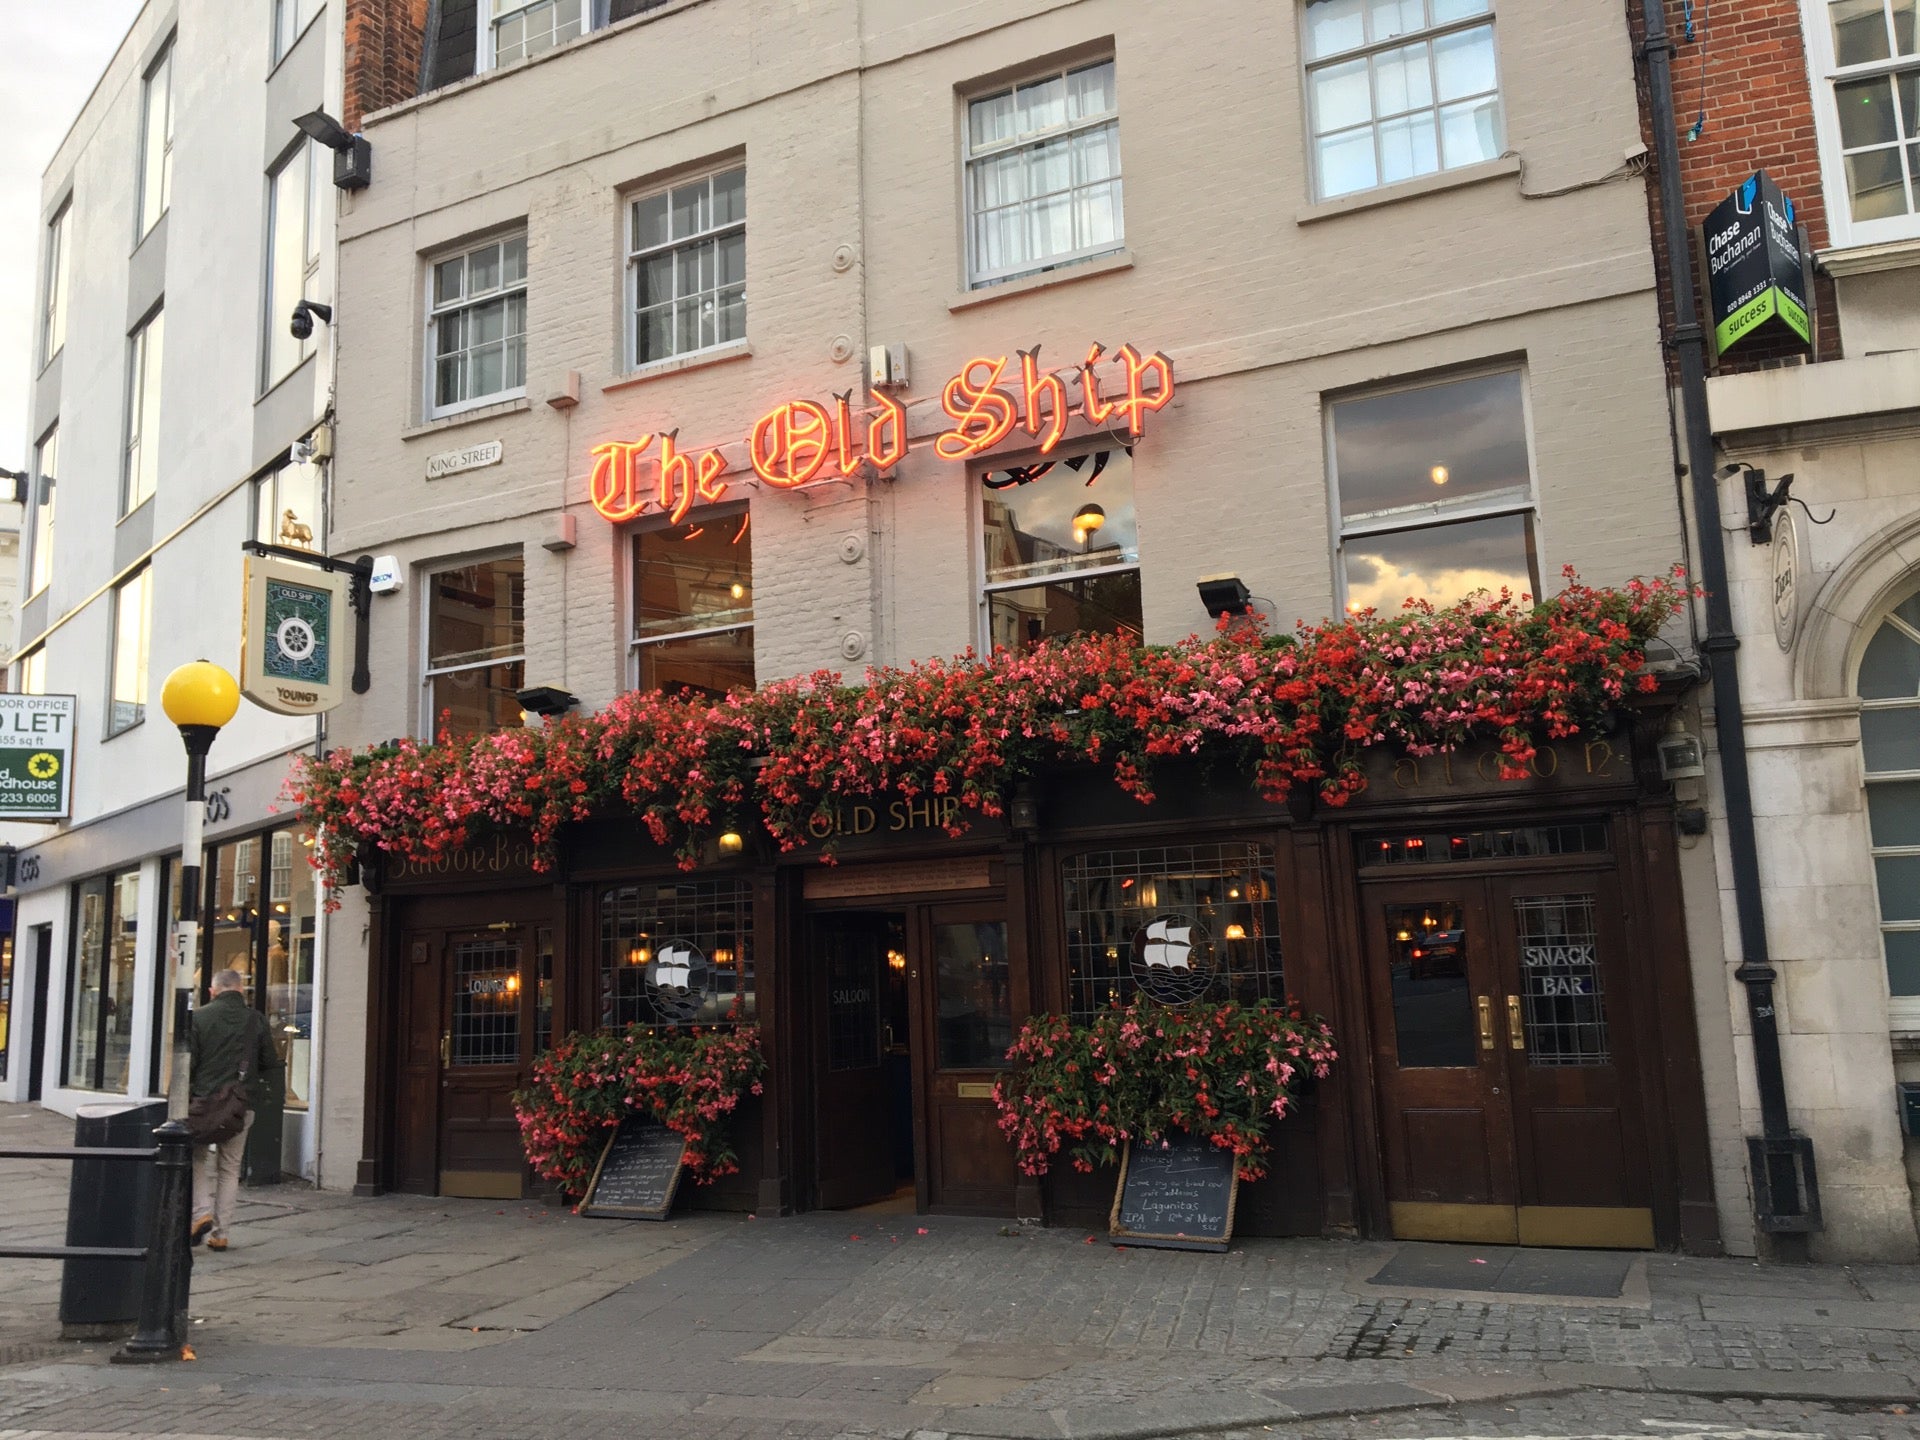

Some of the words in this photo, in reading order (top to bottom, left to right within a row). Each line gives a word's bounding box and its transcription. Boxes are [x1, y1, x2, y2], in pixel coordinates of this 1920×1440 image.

[1767, 201, 1788, 233] Chase
[1709, 221, 1741, 255] Chase
[1710, 226, 1761, 276] Buchanan
[1770, 220, 1801, 263] Buchanan
[1727, 300, 1738, 313] 020
[1737, 290, 1753, 305] 8948
[1753, 279, 1767, 295] 1331
[1728, 300, 1767, 336] success
[1787, 305, 1808, 334] success
[589, 427, 729, 527] The
[749, 388, 909, 489] Old
[934, 341, 1175, 462] Ship
[430, 455, 457, 473] KING
[461, 446, 498, 466] STREET
[281, 589, 297, 598] OLD
[298, 592, 313, 600] SHIP
[27, 699, 69, 710] OFFICE
[14, 712, 67, 733] LET
[19, 738, 33, 748] sq
[36, 736, 44, 746] ft
[1, 793, 23, 803] 233
[27, 793, 57, 803] 6005
[203, 787, 231, 826] OS
[808, 804, 876, 839] OLD
[889, 796, 962, 832] SHIP
[489, 833, 531, 872] Ba
[1525, 946, 1596, 966] SNACK
[833, 988, 871, 1004] SALOON
[1542, 976, 1585, 995] BAR
[1124, 1212, 1145, 1223] IPA
[1197, 1213, 1223, 1223] Never
[1142, 1199, 1201, 1215] Lagunitas
